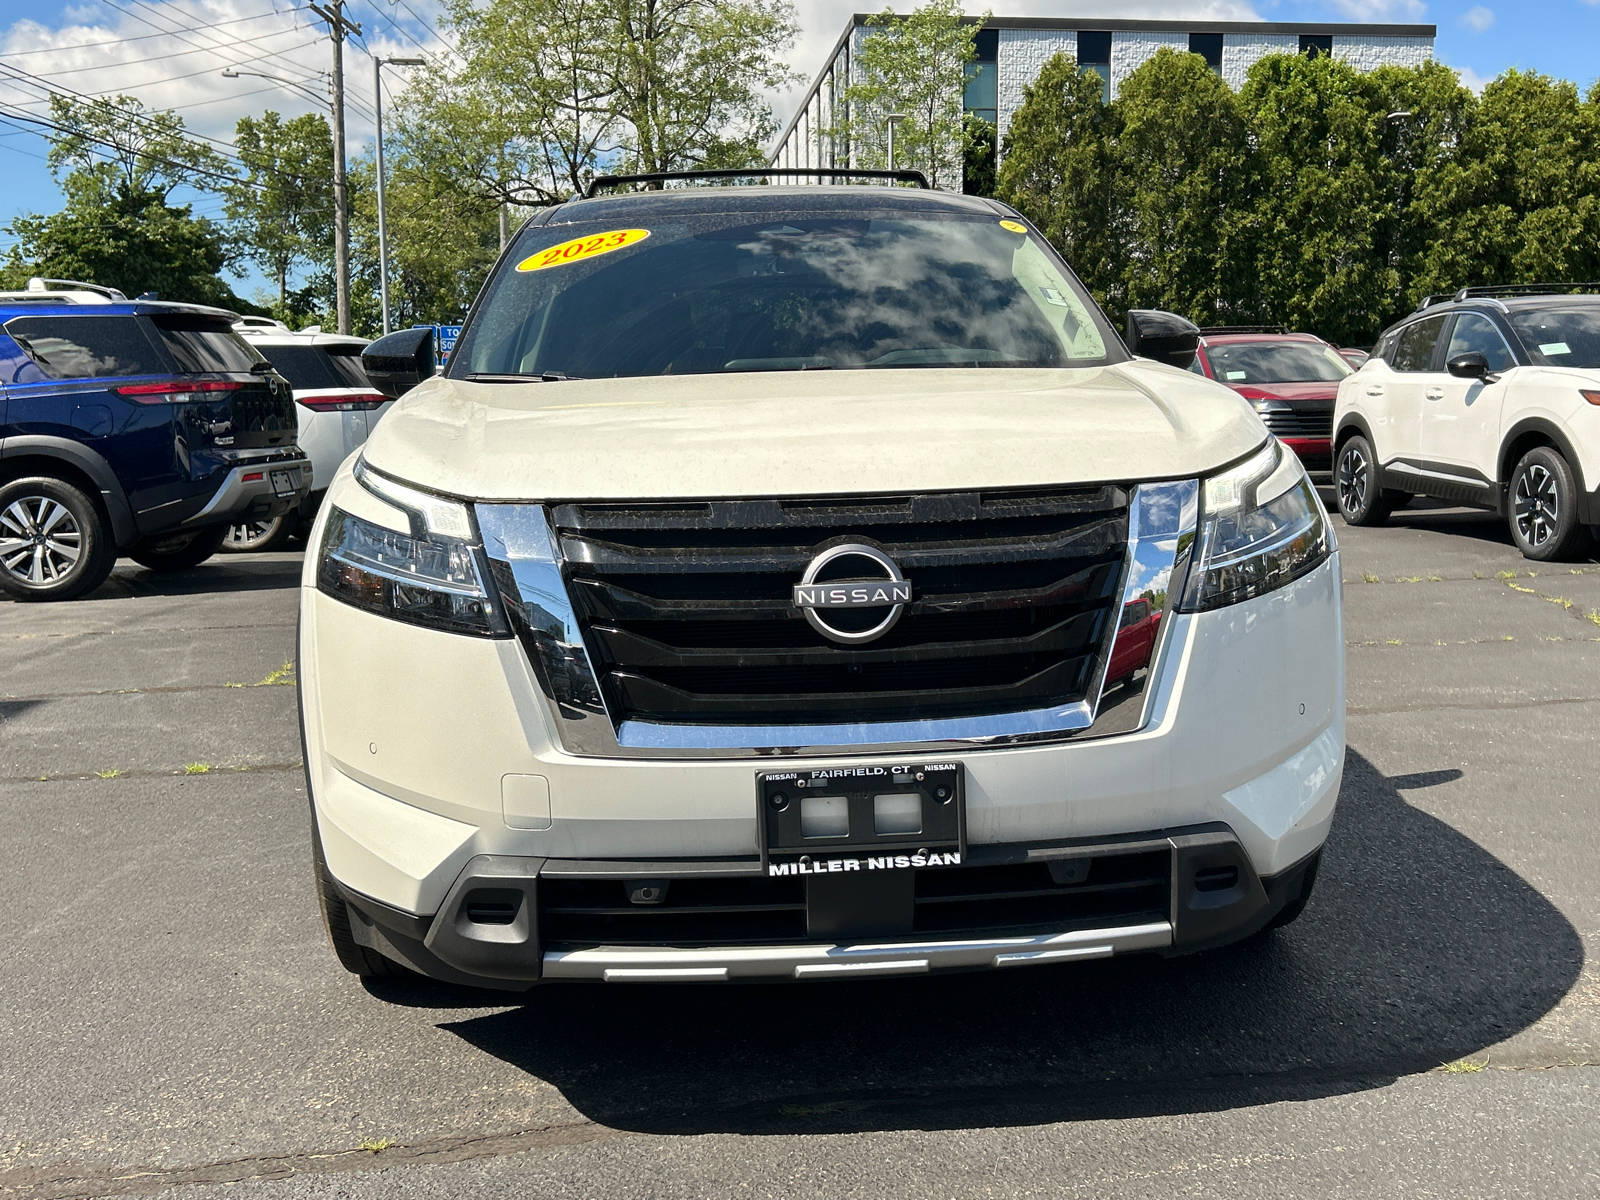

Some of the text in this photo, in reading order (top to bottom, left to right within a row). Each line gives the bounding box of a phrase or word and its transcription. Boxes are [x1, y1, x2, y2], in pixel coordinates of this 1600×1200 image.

[540, 232, 627, 266] 2023
[446, 328, 460, 337] TO
[797, 586, 909, 604] NISSAN
[811, 765, 911, 779] FAIRFIELD, CT
[924, 764, 957, 772] NISSAN
[765, 773, 798, 782] NISSAN
[769, 853, 961, 877] MILLER NISSAN
